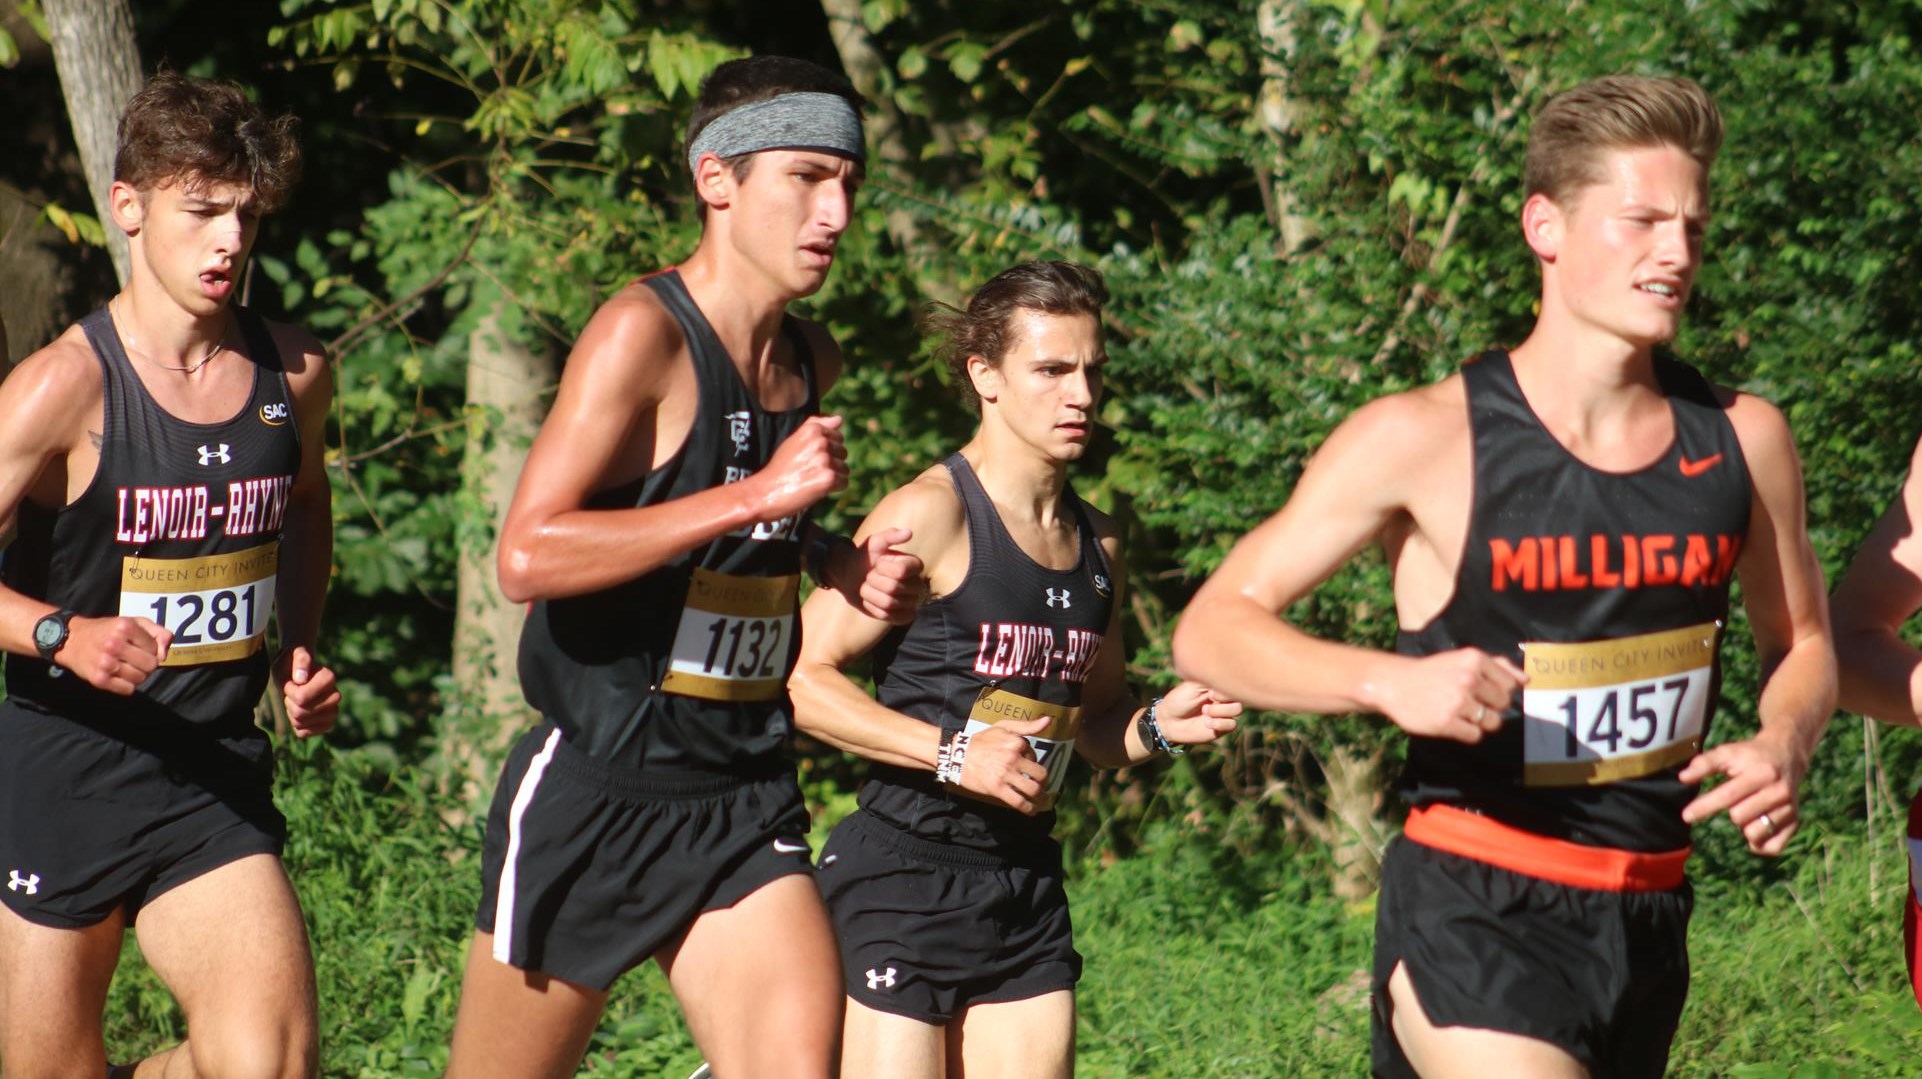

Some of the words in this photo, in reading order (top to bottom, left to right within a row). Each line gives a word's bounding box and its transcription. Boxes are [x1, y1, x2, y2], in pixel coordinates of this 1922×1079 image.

[263, 403, 287, 420] SAC
[131, 568, 188, 581] QUEEN
[195, 564, 230, 578] CITY
[233, 552, 275, 573] INVITE
[150, 585, 256, 644] 1281
[703, 618, 782, 677] 1132
[1534, 657, 1604, 674] QUEEN
[1612, 649, 1650, 668] CITY
[1657, 639, 1702, 661] INVIT
[981, 697, 1033, 721] QUEEN
[1558, 677, 1690, 758] 1457
